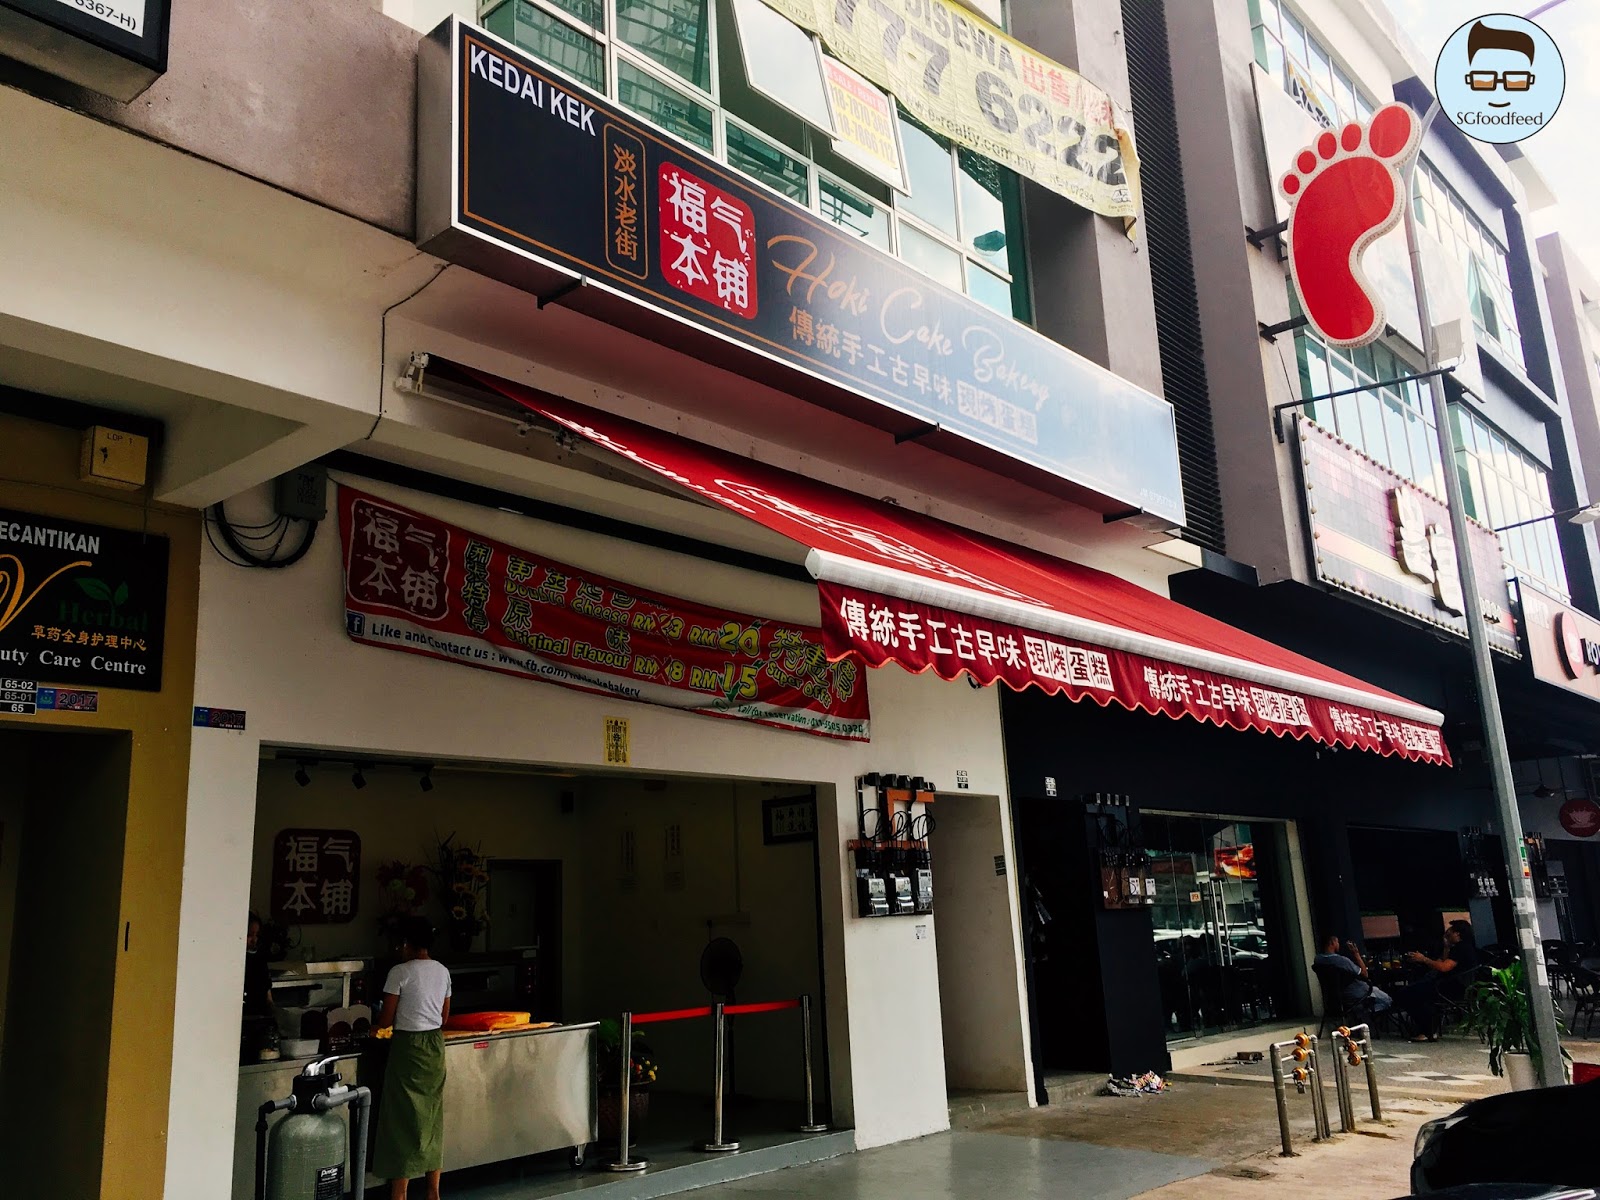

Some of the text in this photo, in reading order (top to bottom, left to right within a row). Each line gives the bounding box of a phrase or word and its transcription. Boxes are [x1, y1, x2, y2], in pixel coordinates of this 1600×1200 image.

[470, 45, 596, 137] KEDAI KEK
[612, 143, 638, 262] 淡水老街
[668, 172, 747, 254] 福气
[669, 233, 749, 309] 本铺
[767, 234, 1050, 412] Hoki Cake Bakery
[0, 520, 100, 554] ECANTIKAN
[362, 508, 438, 567] 福气
[360, 555, 439, 610] 本铺
[56, 599, 149, 632] Herbal
[504, 578, 566, 608] Double
[571, 598, 630, 626] Cheese
[31, 625, 147, 652] 草药全身护理中心
[372, 623, 401, 638] Like
[405, 630, 427, 643] and
[427, 636, 471, 656] Contact
[474, 648, 488, 659] us
[503, 626, 570, 656] Original
[572, 641, 631, 669] Flavour
[633, 655, 685, 683] RM8
[839, 596, 1115, 692] 傳統手工古早味現烤蛋糕
[1, 648, 147, 675] uty Care Centre
[767, 660, 803, 689] Super
[4, 691, 33, 702] 65-01
[5, 680, 34, 690] 65-02
[60, 693, 97, 706] 2017
[11, 703, 25, 713] 65
[212, 711, 245, 725] 2017
[738, 704, 753, 713] Call
[285, 836, 354, 873] 福气
[281, 877, 354, 916] 本铺
